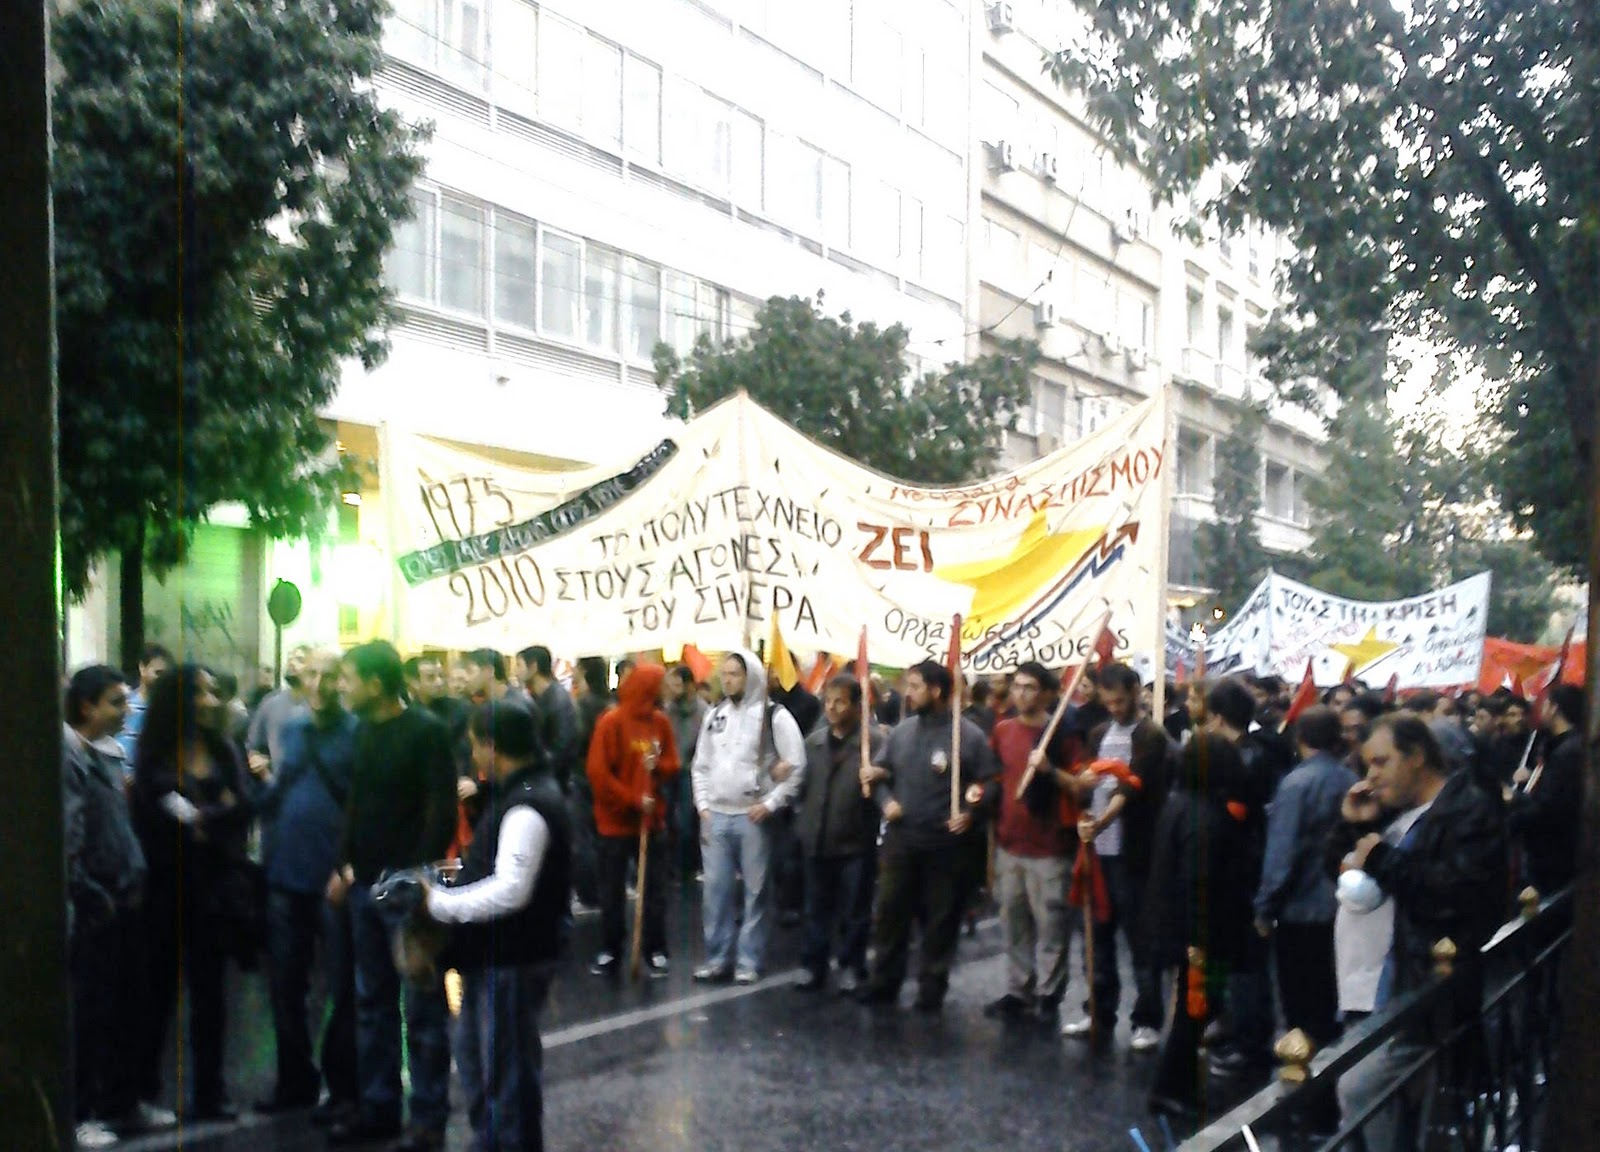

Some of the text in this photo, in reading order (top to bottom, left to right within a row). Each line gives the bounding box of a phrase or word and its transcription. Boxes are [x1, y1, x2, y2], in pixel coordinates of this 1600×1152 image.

[418, 468, 515, 542] 1975
[638, 485, 843, 548] ΠΟΛΥΤΕΧΝΕΙΟ
[857, 521, 934, 573] ΖΕΙ
[449, 553, 545, 628] 2010
[555, 560, 656, 602] ΣΤΟΥΣ
[623, 580, 819, 636] ΤΟΥ ΣΗΕΡΑ
[1384, 593, 1458, 622] ΚΡΙΣΗ
